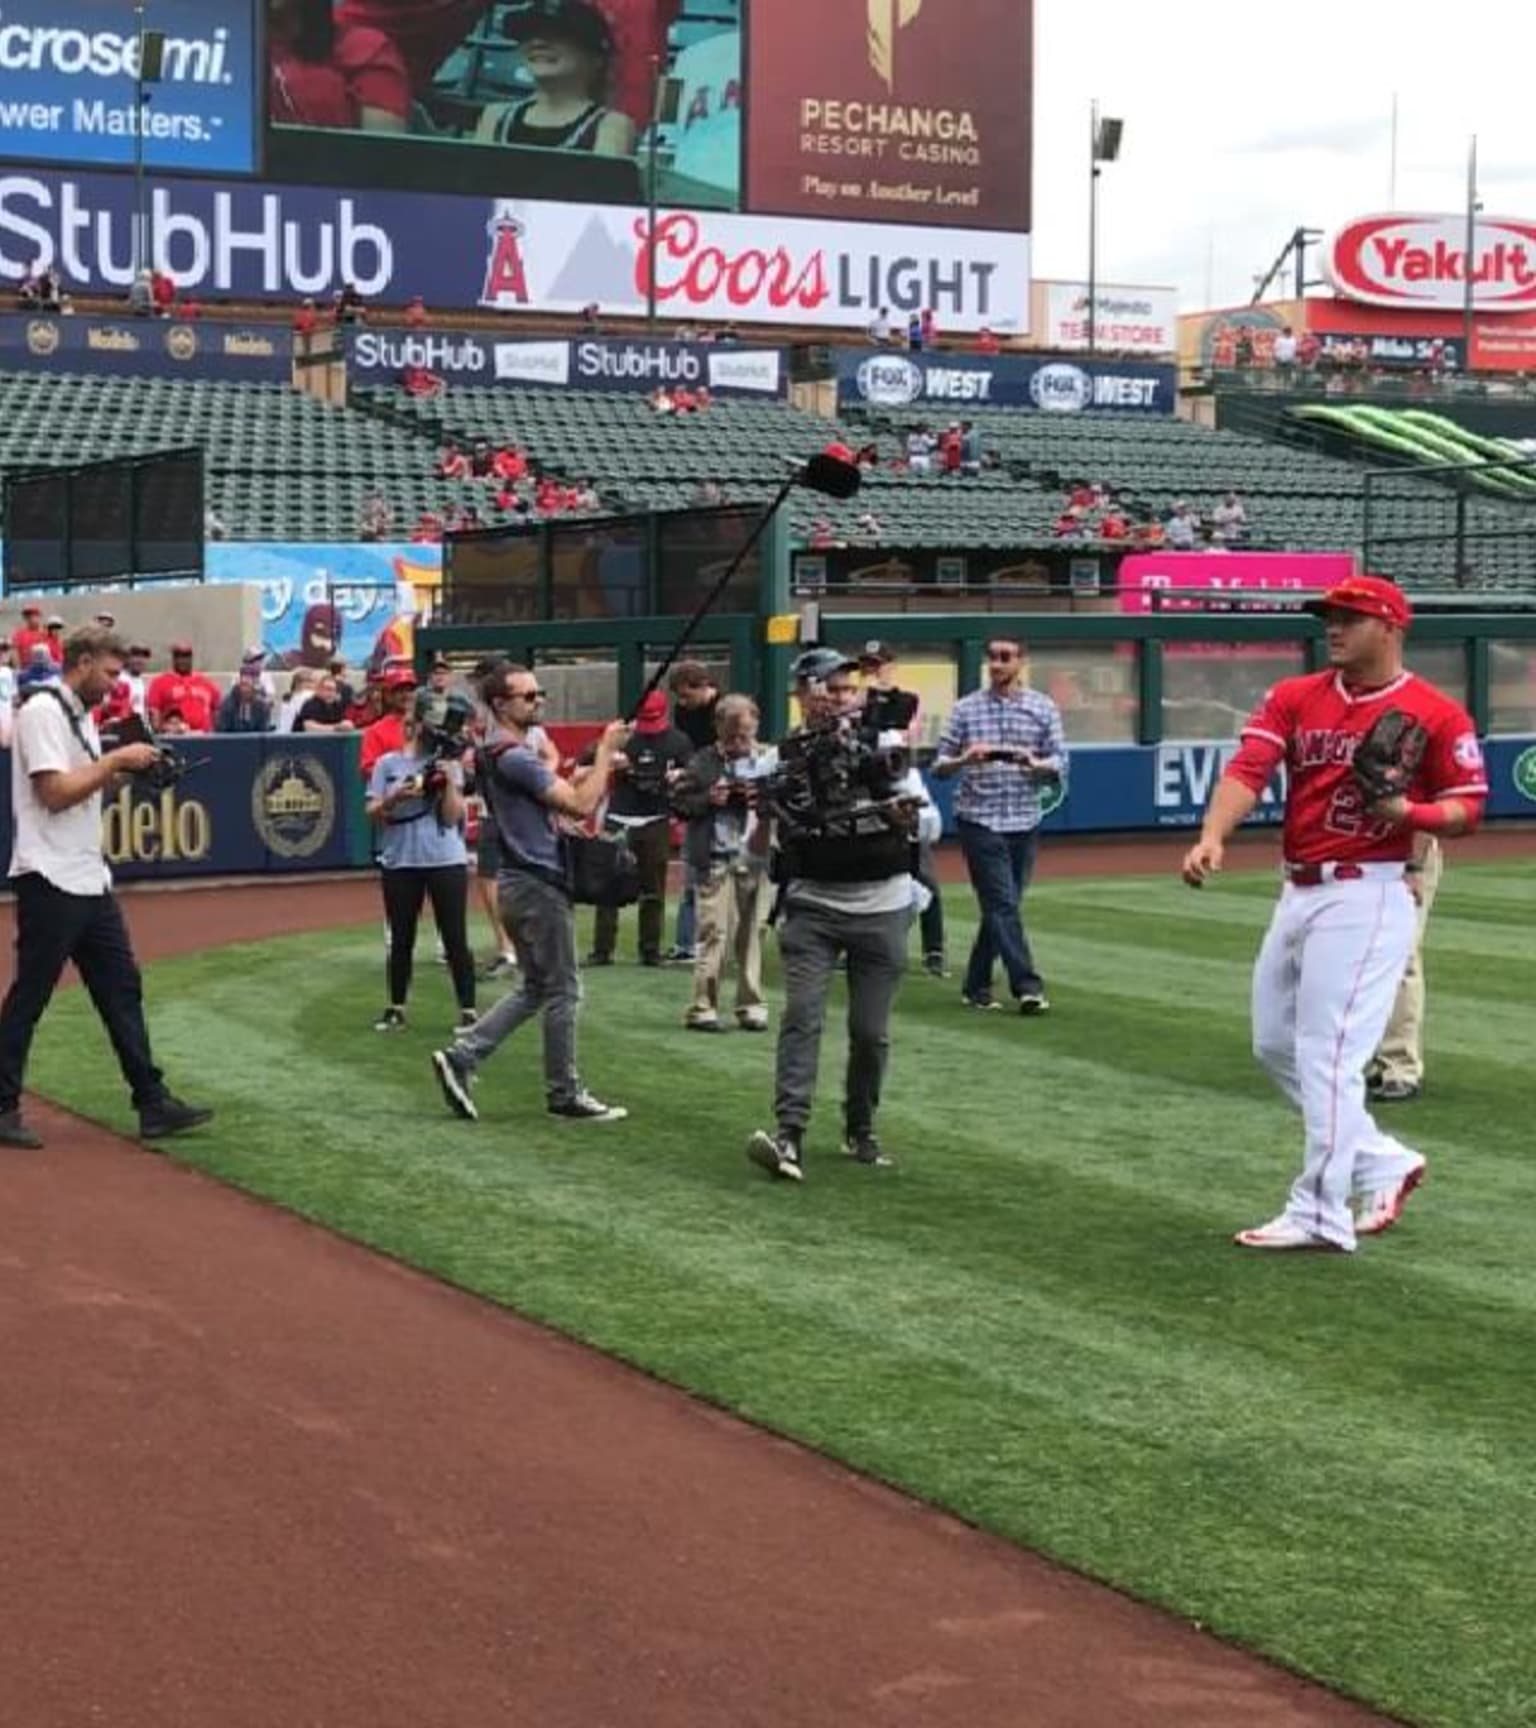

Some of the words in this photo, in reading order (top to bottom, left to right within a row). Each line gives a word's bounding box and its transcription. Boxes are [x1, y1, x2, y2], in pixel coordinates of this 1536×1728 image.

[801, 98, 978, 141] PECHANGA
[801, 134, 887, 156] RESORT
[899, 143, 980, 165] CASINO
[804, 176, 836, 198] Play
[866, 181, 931, 202] Another
[936, 186, 980, 206] Level
[633, 213, 830, 310] Coors
[839, 254, 998, 314] LIGHT
[355, 334, 486, 371] StubHub
[578, 343, 700, 380] StubHub
[870, 365, 907, 386] FOX
[925, 368, 994, 399] WEST
[1042, 374, 1075, 394] FOX
[1093, 375, 1160, 405] WEST
[101, 785, 210, 863] delo
